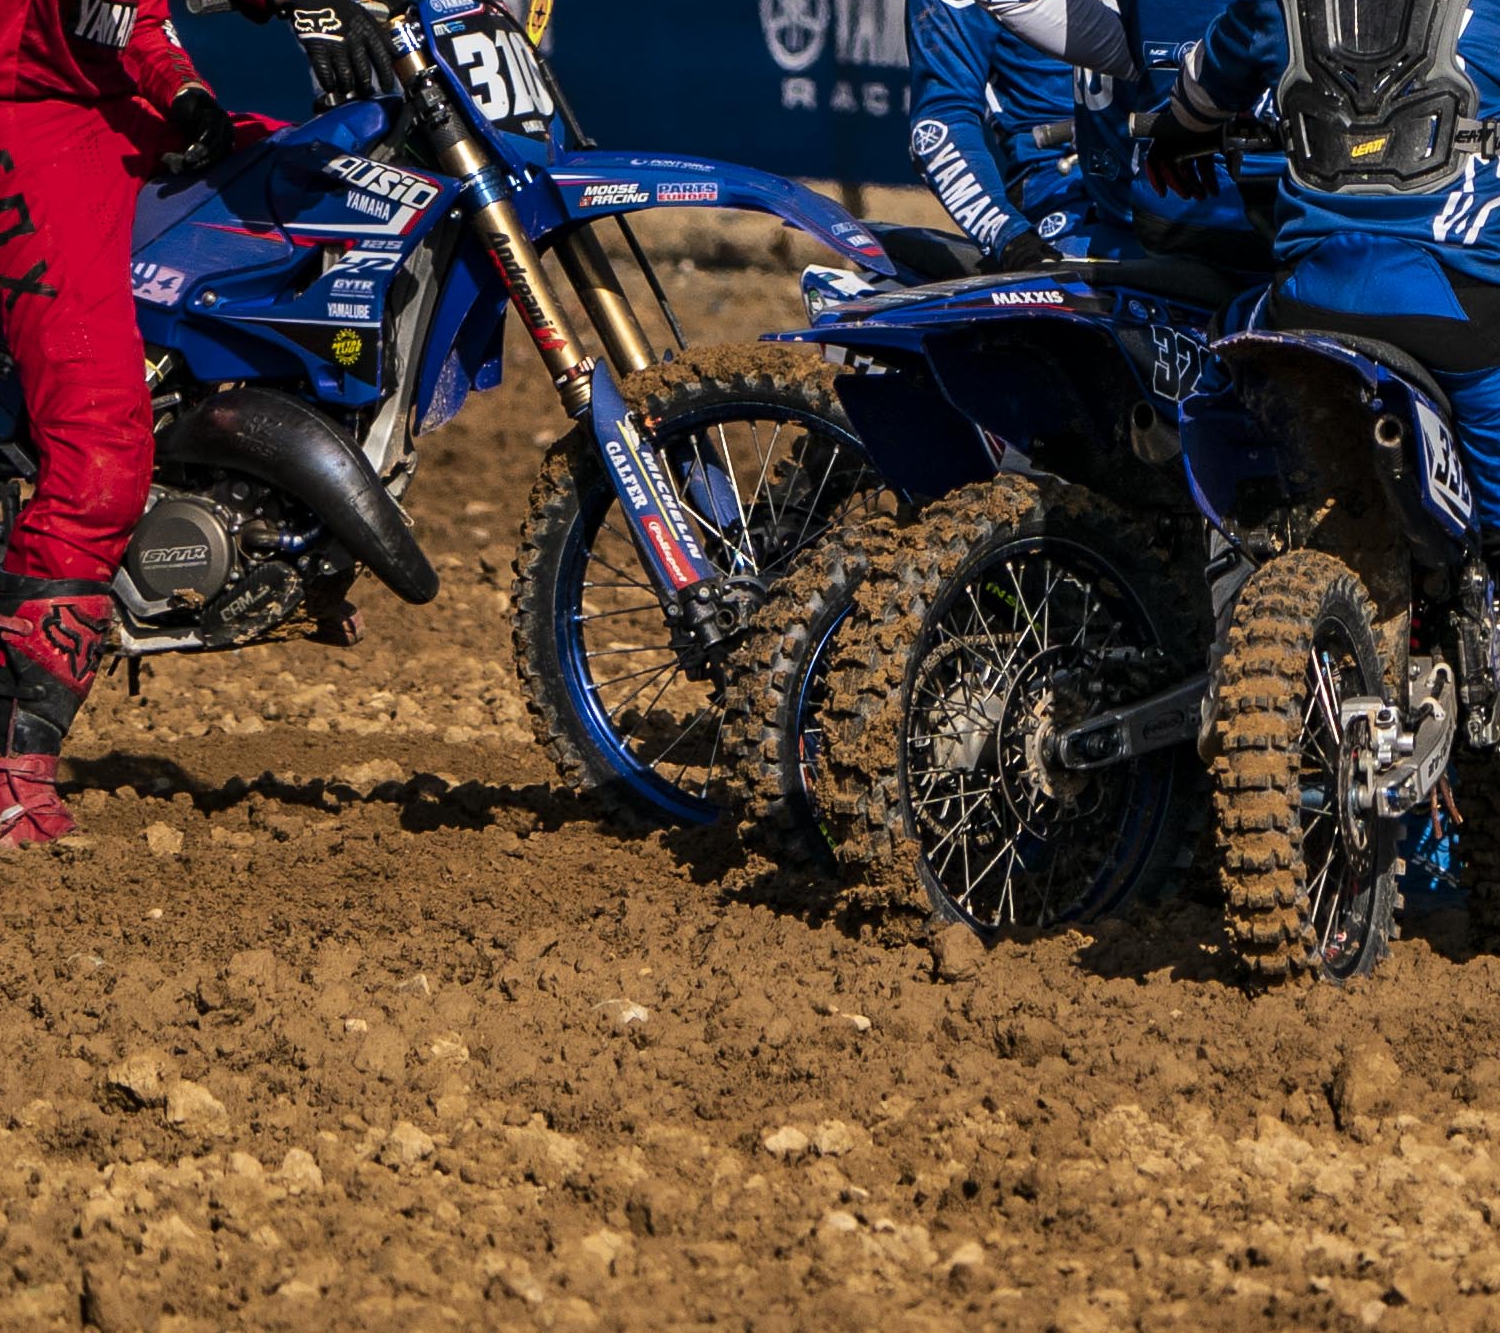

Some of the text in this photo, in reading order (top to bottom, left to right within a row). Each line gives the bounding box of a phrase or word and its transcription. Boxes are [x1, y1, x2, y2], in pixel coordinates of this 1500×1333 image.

[451, 29, 554, 121] 310
[1352, 138, 1386, 157] LEATT
[583, 183, 640, 195] MOOSE
[657, 183, 717, 194] PARTS
[657, 193, 718, 202] EUROPE
[346, 190, 392, 221] YAMAHA
[590, 192, 650, 206] RACING
[332, 280, 375, 291] GYTR
[490, 232, 555, 327] Andreani
[991, 290, 1065, 305] MAXXIS
[327, 302, 372, 320] YAMALUBE
[605, 440, 649, 510] GALFER
[640, 450, 703, 560] MICHELIN
[141, 544, 209, 563] GYTR
